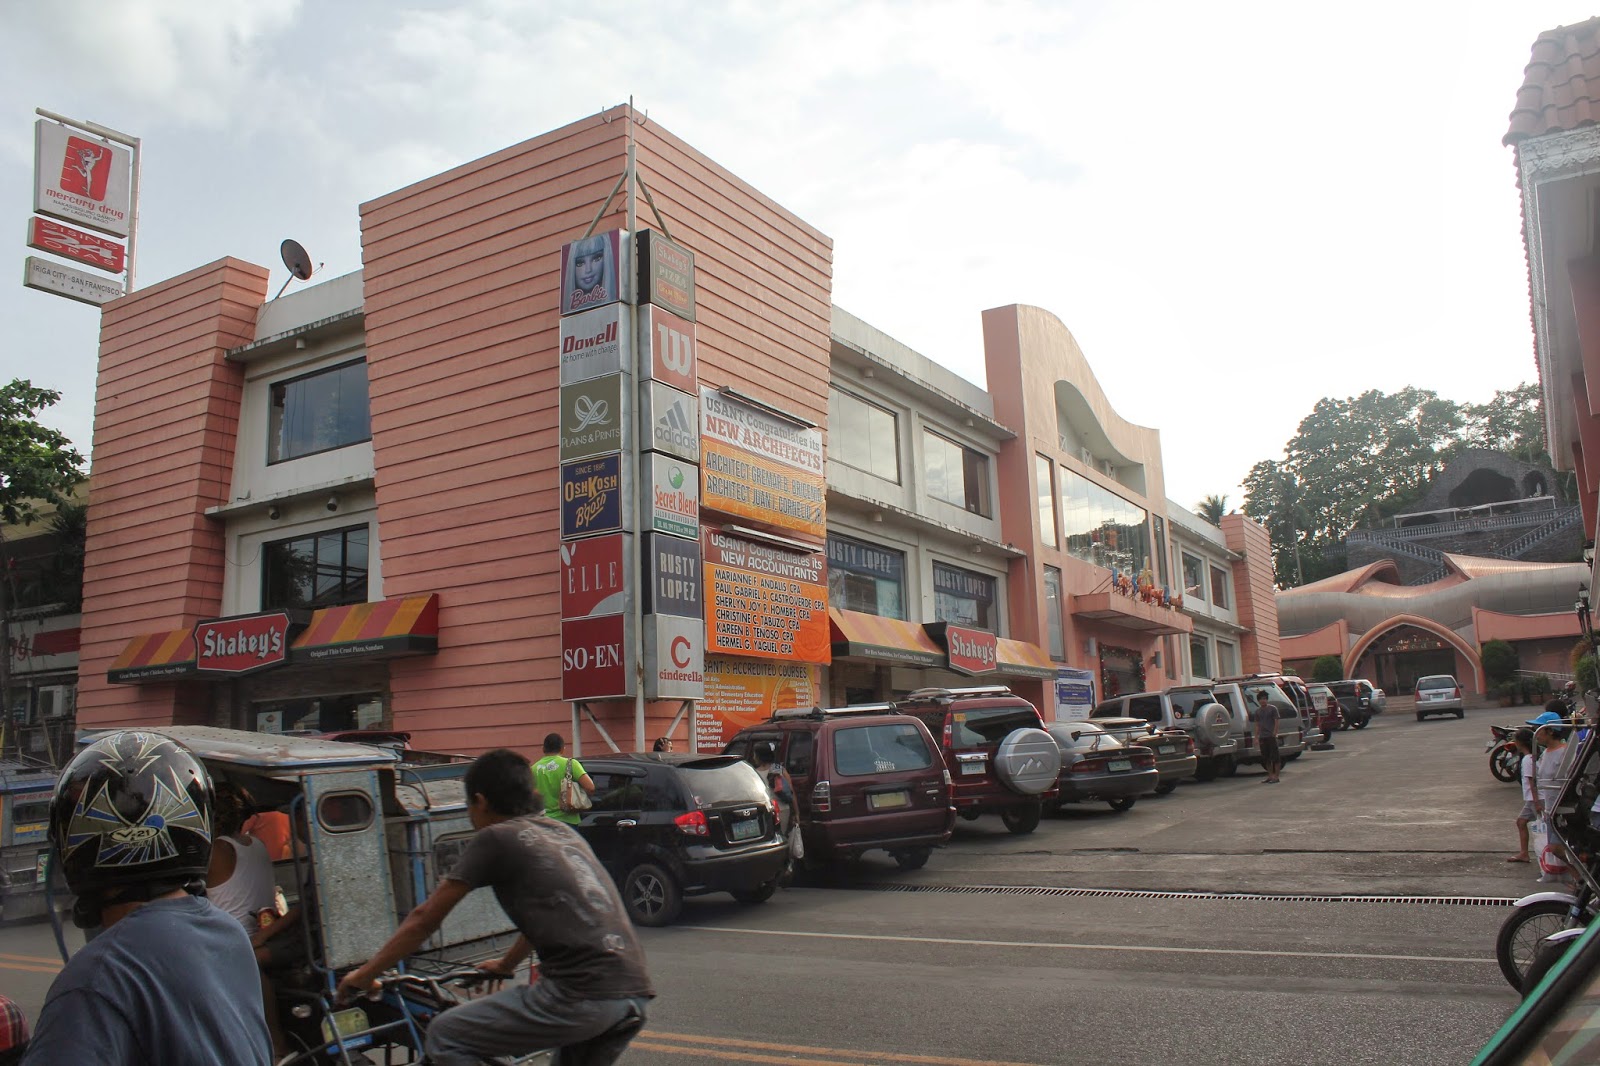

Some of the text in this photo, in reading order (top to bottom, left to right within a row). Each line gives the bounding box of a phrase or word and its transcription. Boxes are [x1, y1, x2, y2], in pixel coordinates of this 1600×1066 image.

[46, 188, 124, 220] mercury drug
[42, 221, 118, 250] GISING
[44, 240, 114, 266] ORAS
[33, 264, 51, 275] IRIGA
[52, 270, 67, 280] CITY
[71, 276, 84, 286] SAN
[85, 280, 120, 296] FRANCISCO
[658, 266, 688, 290] PIZZA
[570, 284, 608, 310] Barbie
[562, 320, 618, 354] Dowell
[562, 353, 569, 363] At
[569, 350, 586, 363] home
[585, 347, 597, 359] with
[561, 427, 621, 448] PLAINS & PRINTS
[655, 423, 697, 451] adidas
[706, 396, 820, 452] USANT Congratulates its
[706, 414, 820, 471] NEW ARCHITECTS
[575, 464, 592, 476] SINCE
[706, 451, 750, 480] ARCHITECT
[564, 475, 617, 503] OSHKOSH
[655, 484, 697, 516] Secret Blend
[706, 474, 751, 502] ARCHITECT
[752, 488, 771, 509] JUAN
[711, 533, 823, 570] USANT Congratulates its
[828, 540, 891, 574] USTY LOPEZ
[568, 561, 617, 594] ELLE
[660, 552, 695, 579] RUSTY
[715, 568, 752, 586] MARIANNE
[721, 549, 818, 582] NEW ACCOUNTANTS
[660, 577, 696, 602] LOPEZ
[715, 582, 732, 595] PAUL
[734, 585, 761, 600] GABRIEL
[762, 590, 768, 601] A.
[935, 569, 987, 597] RUSTY LOPEZ
[715, 595, 746, 610] SHERLYN
[748, 600, 761, 611] JOY
[798, 609, 810, 619] CPA
[715, 608, 751, 624] CHRISTINE
[788, 619, 800, 630] CPA
[203, 625, 282, 659] Shakey's
[716, 622, 743, 636] KAREEN
[745, 626, 751, 636] B.
[782, 631, 794, 642] CPA
[716, 635, 742, 649] HERMEL
[780, 643, 792, 654] CPA
[310, 649, 328, 658] Original
[563, 643, 620, 672] SO-EN
[951, 632, 995, 665] Shakey's
[659, 666, 703, 683] cinderella
[703, 659, 808, 679] SANT's ACCREDITED COURSES
[696, 712, 714, 720] Nursing
[696, 719, 723, 727] Criminology
